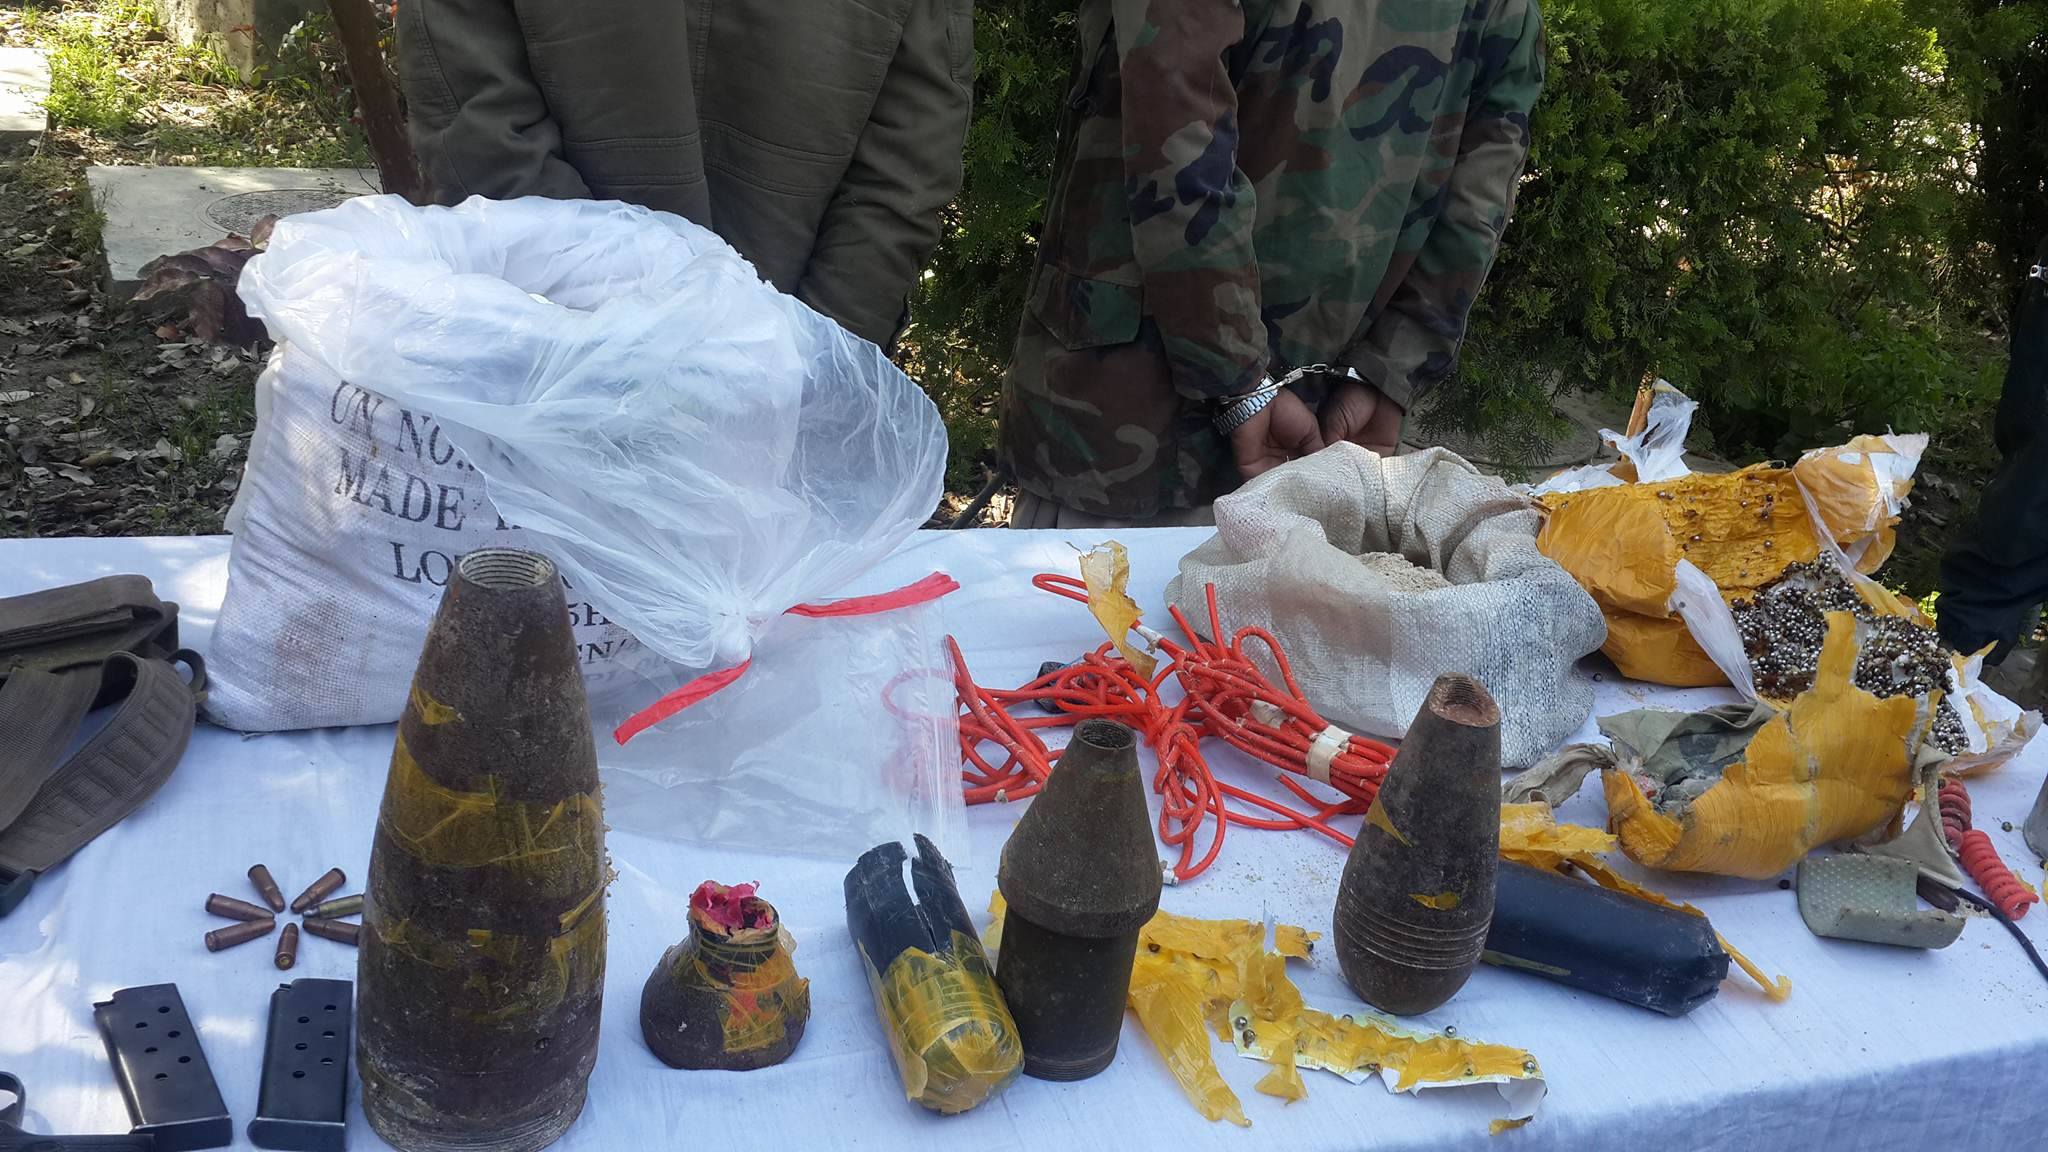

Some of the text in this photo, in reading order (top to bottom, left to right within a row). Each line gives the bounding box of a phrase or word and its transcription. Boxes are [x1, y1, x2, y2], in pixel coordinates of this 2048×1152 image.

[330, 379, 383, 440] UN
[334, 446, 467, 531] MADE
[389, 541, 464, 587] LO
